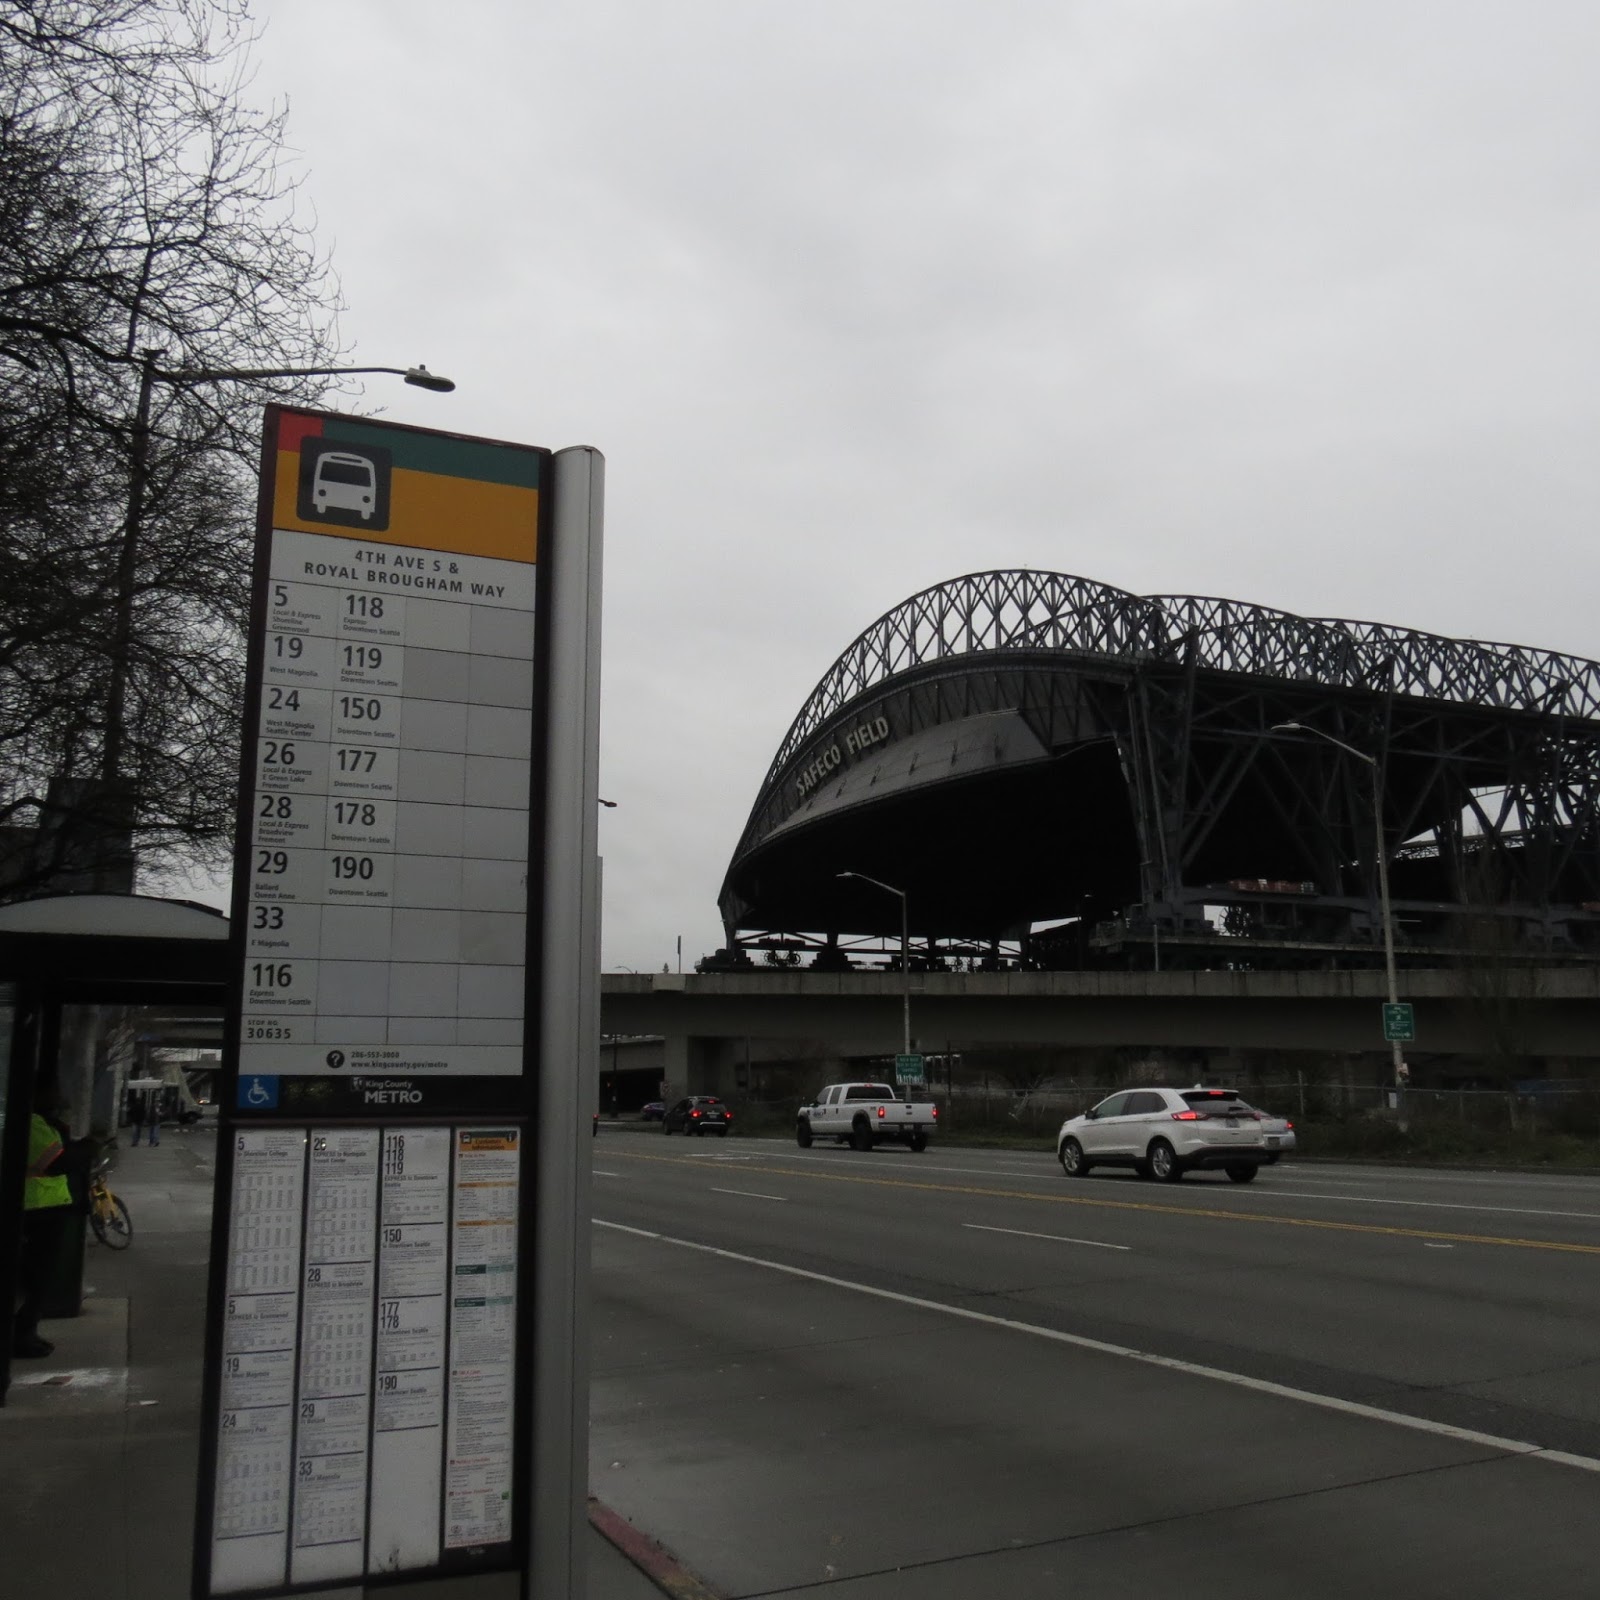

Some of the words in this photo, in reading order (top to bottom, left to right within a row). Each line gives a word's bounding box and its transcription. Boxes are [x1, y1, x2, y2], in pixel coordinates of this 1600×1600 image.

[355, 550, 386, 565] 4TH
[394, 556, 425, 570] AVE
[433, 560, 441, 572] S
[449, 563, 459, 575] &
[304, 562, 359, 580] ROYAL
[368, 570, 463, 593] BROUGHAM
[471, 583, 505, 598] WAY
[275, 585, 288, 607] 5
[346, 594, 384, 618] 118
[298, 611, 321, 620] Express
[343, 624, 377, 634] Downtown
[379, 628, 400, 636] Seattle
[274, 636, 303, 659] 19
[344, 646, 382, 669] 119
[270, 666, 286, 674] West
[287, 668, 318, 677] Magnolia
[341, 668, 364, 676] Express
[341, 676, 375, 685] Downtown
[268, 688, 300, 711] 24
[340, 697, 381, 721] 150
[284, 721, 315, 730] Magnolia
[337, 728, 372, 737] Downtown
[291, 729, 312, 737] Center
[263, 741, 295, 765] 26
[796, 744, 841, 796] SAFECO
[846, 716, 889, 755] FIELD
[337, 749, 377, 773] 177
[288, 768, 312, 776] Express
[334, 781, 369, 789] Downtown
[260, 795, 292, 819] 28
[334, 802, 376, 826] 178
[284, 822, 309, 830] Express
[258, 836, 286, 844] Fremont
[331, 834, 366, 843] Downtown
[368, 836, 390, 844] Seattle
[257, 850, 288, 874] 29
[332, 856, 374, 880] 190
[255, 883, 279, 891] Ballard
[328, 889, 364, 897] Downtown
[254, 891, 276, 900] Queen
[253, 906, 284, 930] 33
[258, 940, 289, 949] Magnolia
[253, 963, 292, 987] 116
[249, 989, 274, 997] Express
[249, 998, 286, 1006] Downtown
[288, 998, 311, 1006] Seattle
[247, 1028, 291, 1039] 30635
[351, 1061, 448, 1069] www.kingcounty.gov/metro
[366, 1080, 384, 1089] King
[385, 1080, 413, 1089] County
[364, 1090, 423, 1104] METRO
[238, 1137, 245, 1151] 5
[314, 1137, 327, 1151] 26
[387, 1135, 405, 1149] 116
[386, 1149, 404, 1162] 118
[385, 1162, 404, 1175] 119
[383, 1229, 402, 1242] 150
[308, 1268, 321, 1282] 28
[228, 1300, 236, 1315] 5
[381, 1301, 400, 1315] 177
[381, 1315, 399, 1329] 178
[226, 1358, 240, 1372] 19
[378, 1375, 397, 1390] 190
[301, 1403, 315, 1418] 29
[222, 1414, 237, 1428] 24
[299, 1461, 313, 1476] 33
